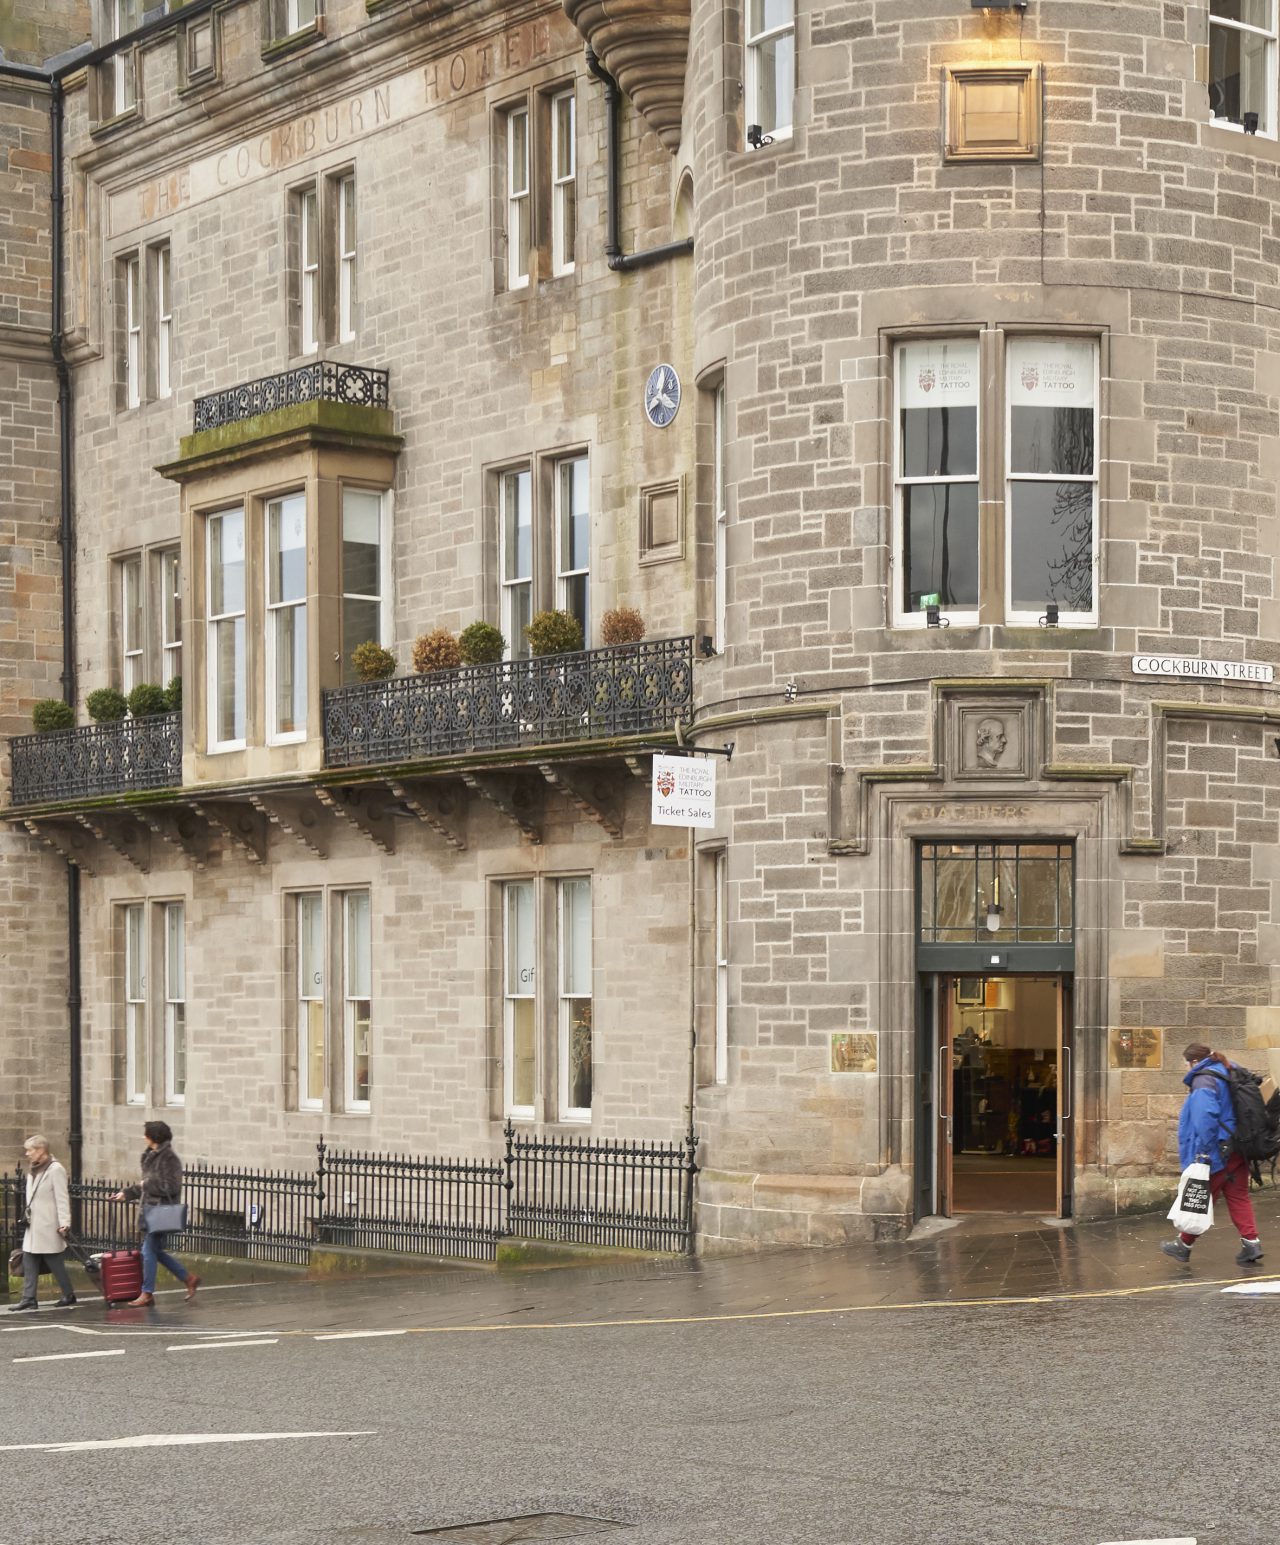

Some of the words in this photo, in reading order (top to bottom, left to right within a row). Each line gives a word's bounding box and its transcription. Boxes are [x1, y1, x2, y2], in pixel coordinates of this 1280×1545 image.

[138, 168, 191, 220] THE
[216, 85, 391, 187] COCKBURN
[423, 23, 549, 104] HOTEL
[1137, 658, 1219, 676] COCKBURN
[1224, 663, 1269, 680] STREET
[679, 787, 712, 797] TATTOO
[657, 805, 685, 816] Ticket
[688, 808, 711, 818] Sales
